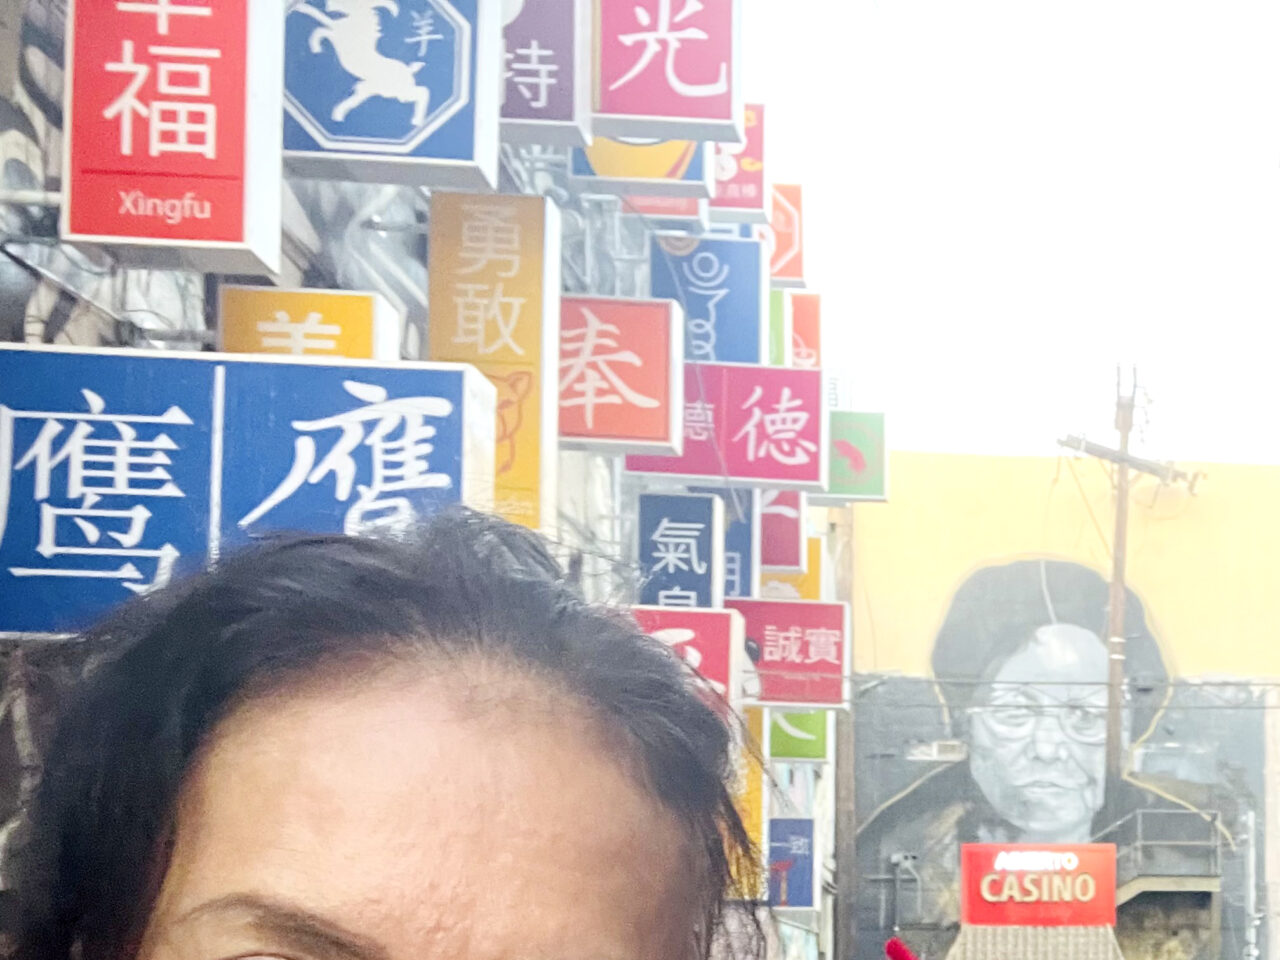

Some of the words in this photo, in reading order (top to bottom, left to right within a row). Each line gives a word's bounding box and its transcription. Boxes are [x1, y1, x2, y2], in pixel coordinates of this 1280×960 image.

[404, 11, 445, 57] 羊
[608, 0, 729, 98] 光
[451, 203, 527, 356] 勇敢
[732, 385, 818, 465] 德
[763, 624, 842, 665] 誠實
[980, 872, 1096, 903] CASINO
